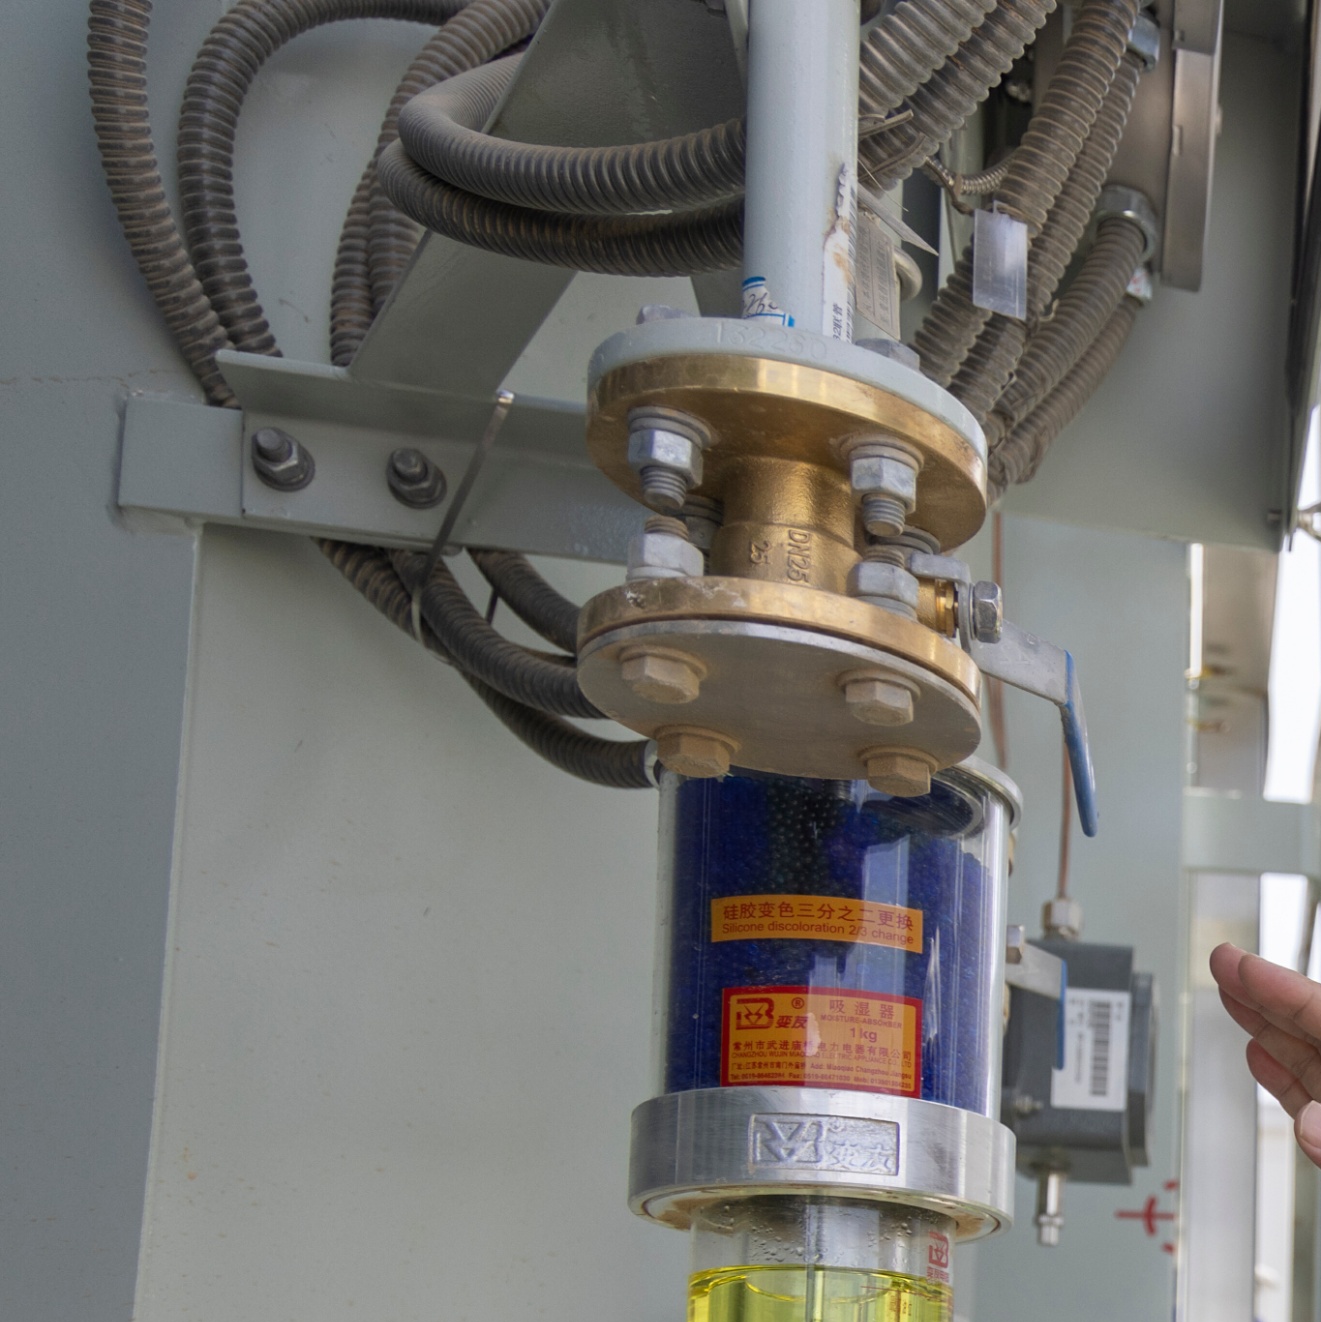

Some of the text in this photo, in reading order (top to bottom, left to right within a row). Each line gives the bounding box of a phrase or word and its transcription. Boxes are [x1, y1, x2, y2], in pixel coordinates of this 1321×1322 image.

[787, 529, 811, 583] DN25
[723, 901, 914, 931] 硅胶变色三分之二更换
[722, 920, 914, 945] Silicone discoloration 2/3 change
[829, 999, 895, 1020] 吸湿器
